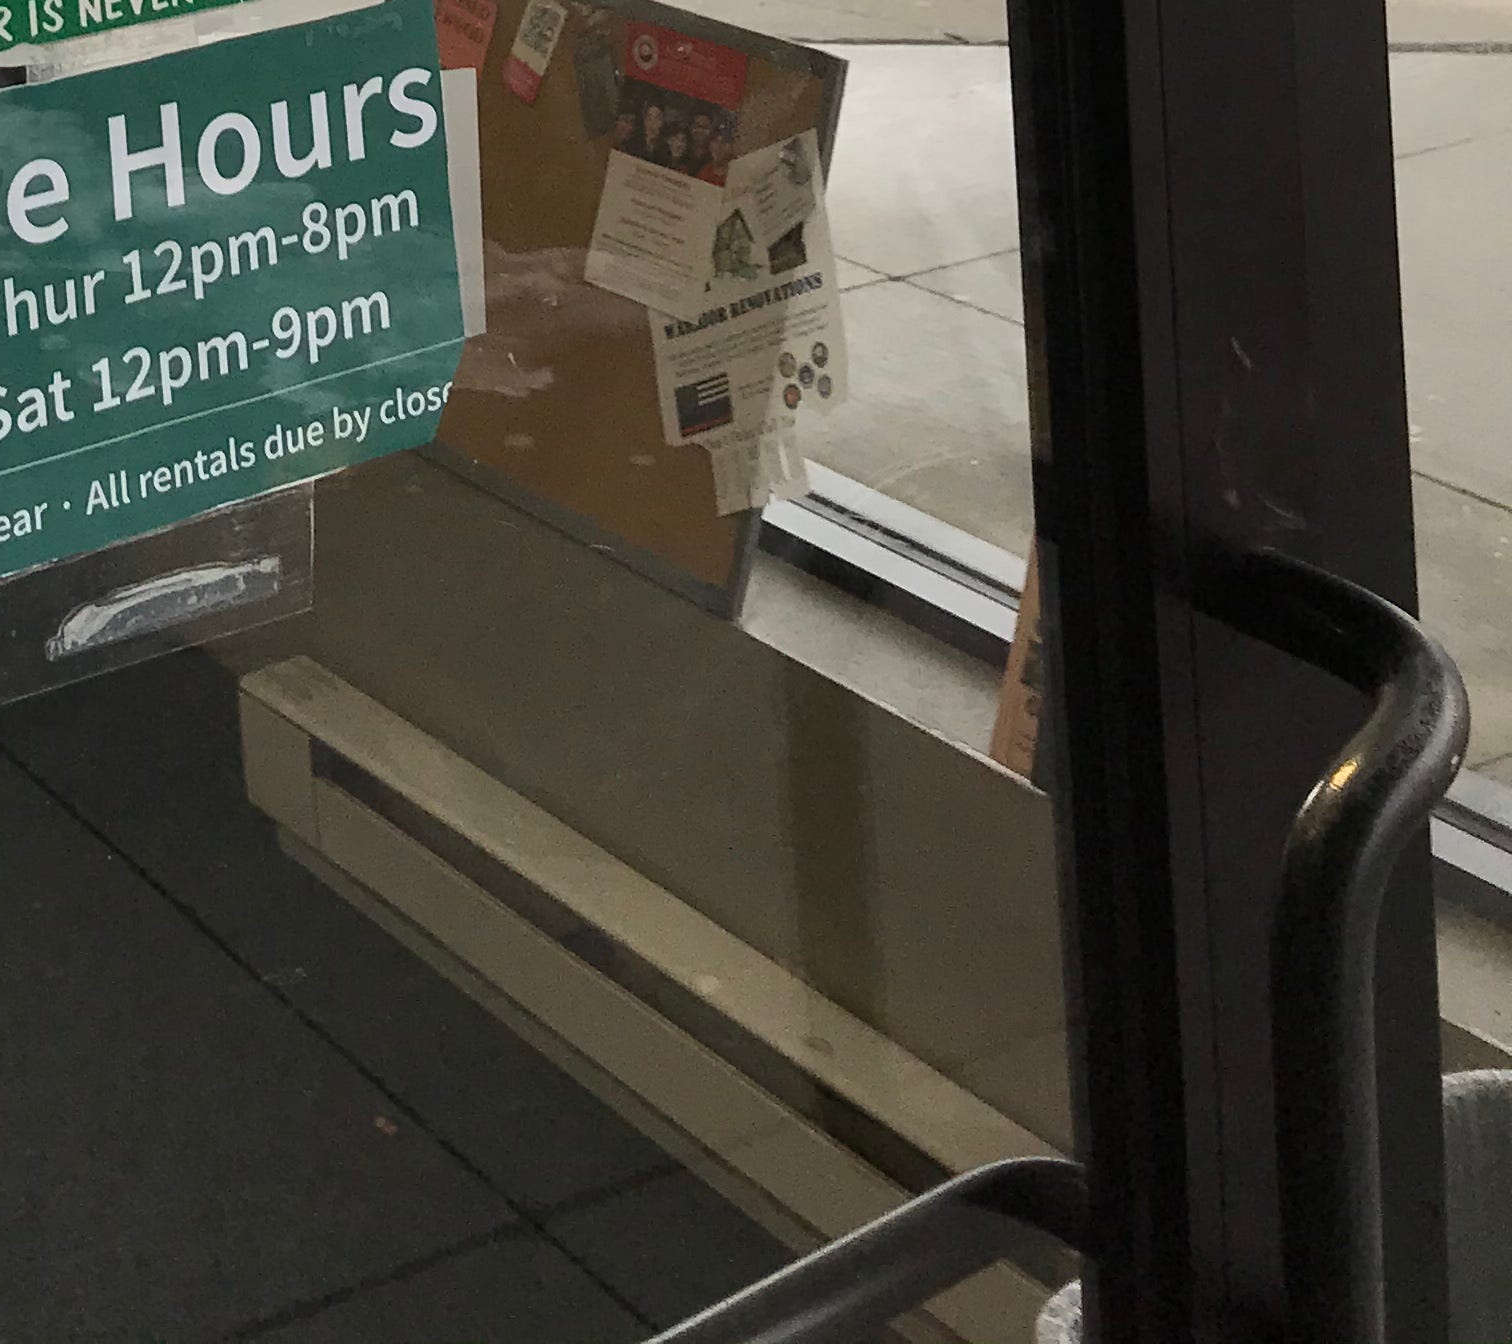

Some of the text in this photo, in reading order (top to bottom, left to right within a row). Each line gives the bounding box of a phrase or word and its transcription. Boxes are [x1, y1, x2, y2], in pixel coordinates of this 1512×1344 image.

[106, 65, 439, 221] Hours
[121, 186, 420, 306] 12pm-8pm
[91, 287, 391, 410] 12pm-9pm
[85, 469, 130, 516] All
[138, 429, 256, 499] rentals
[263, 419, 324, 461] due
[333, 406, 371, 443] by
